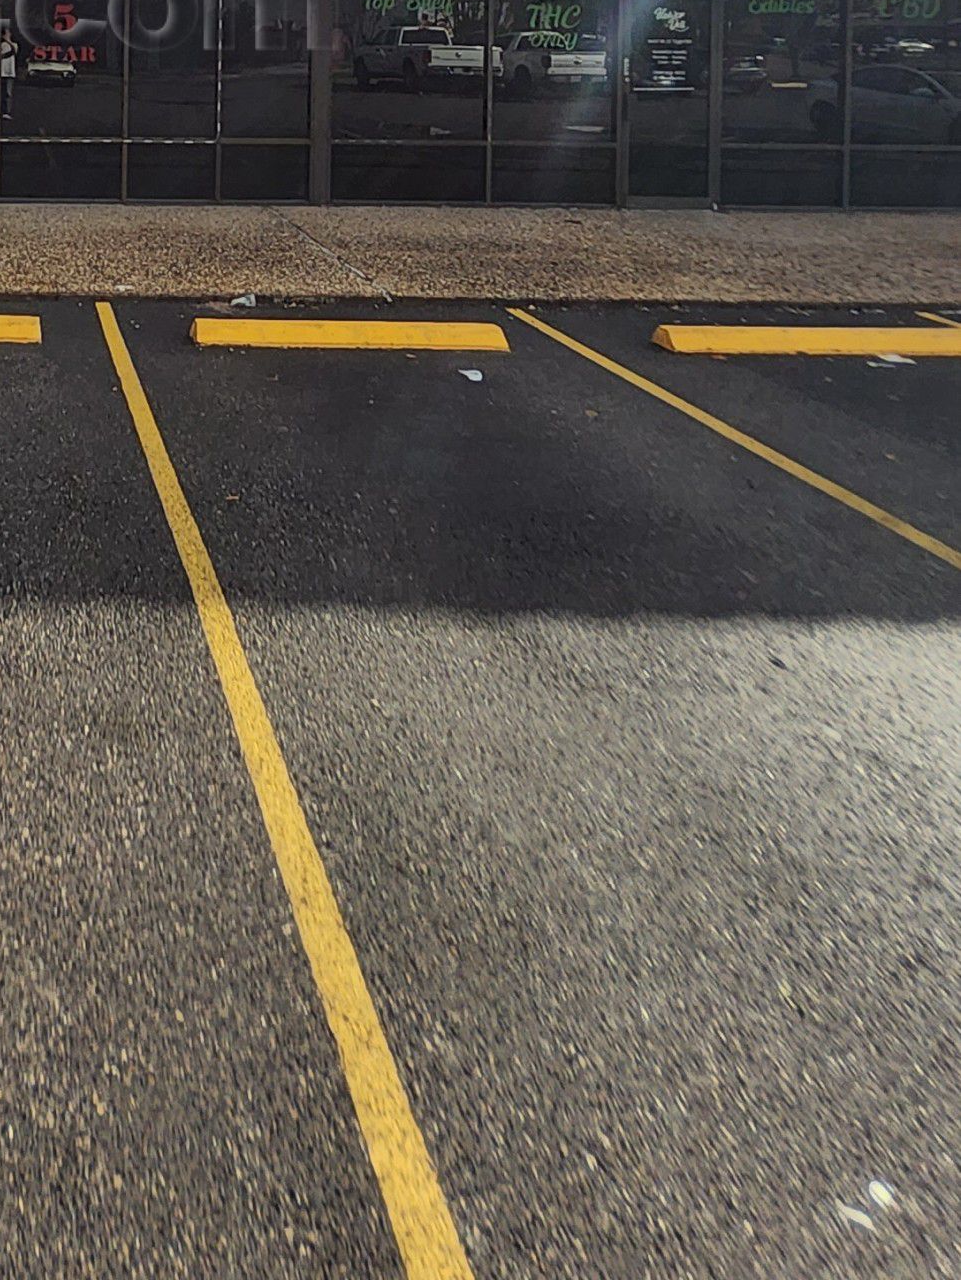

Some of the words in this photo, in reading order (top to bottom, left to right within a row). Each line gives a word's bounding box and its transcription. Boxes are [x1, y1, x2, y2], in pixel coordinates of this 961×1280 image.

[53, 3, 78, 32] 5
[526, 3, 582, 30] THC
[528, 31, 579, 51] ONLY
[32, 45, 97, 63] STAR
